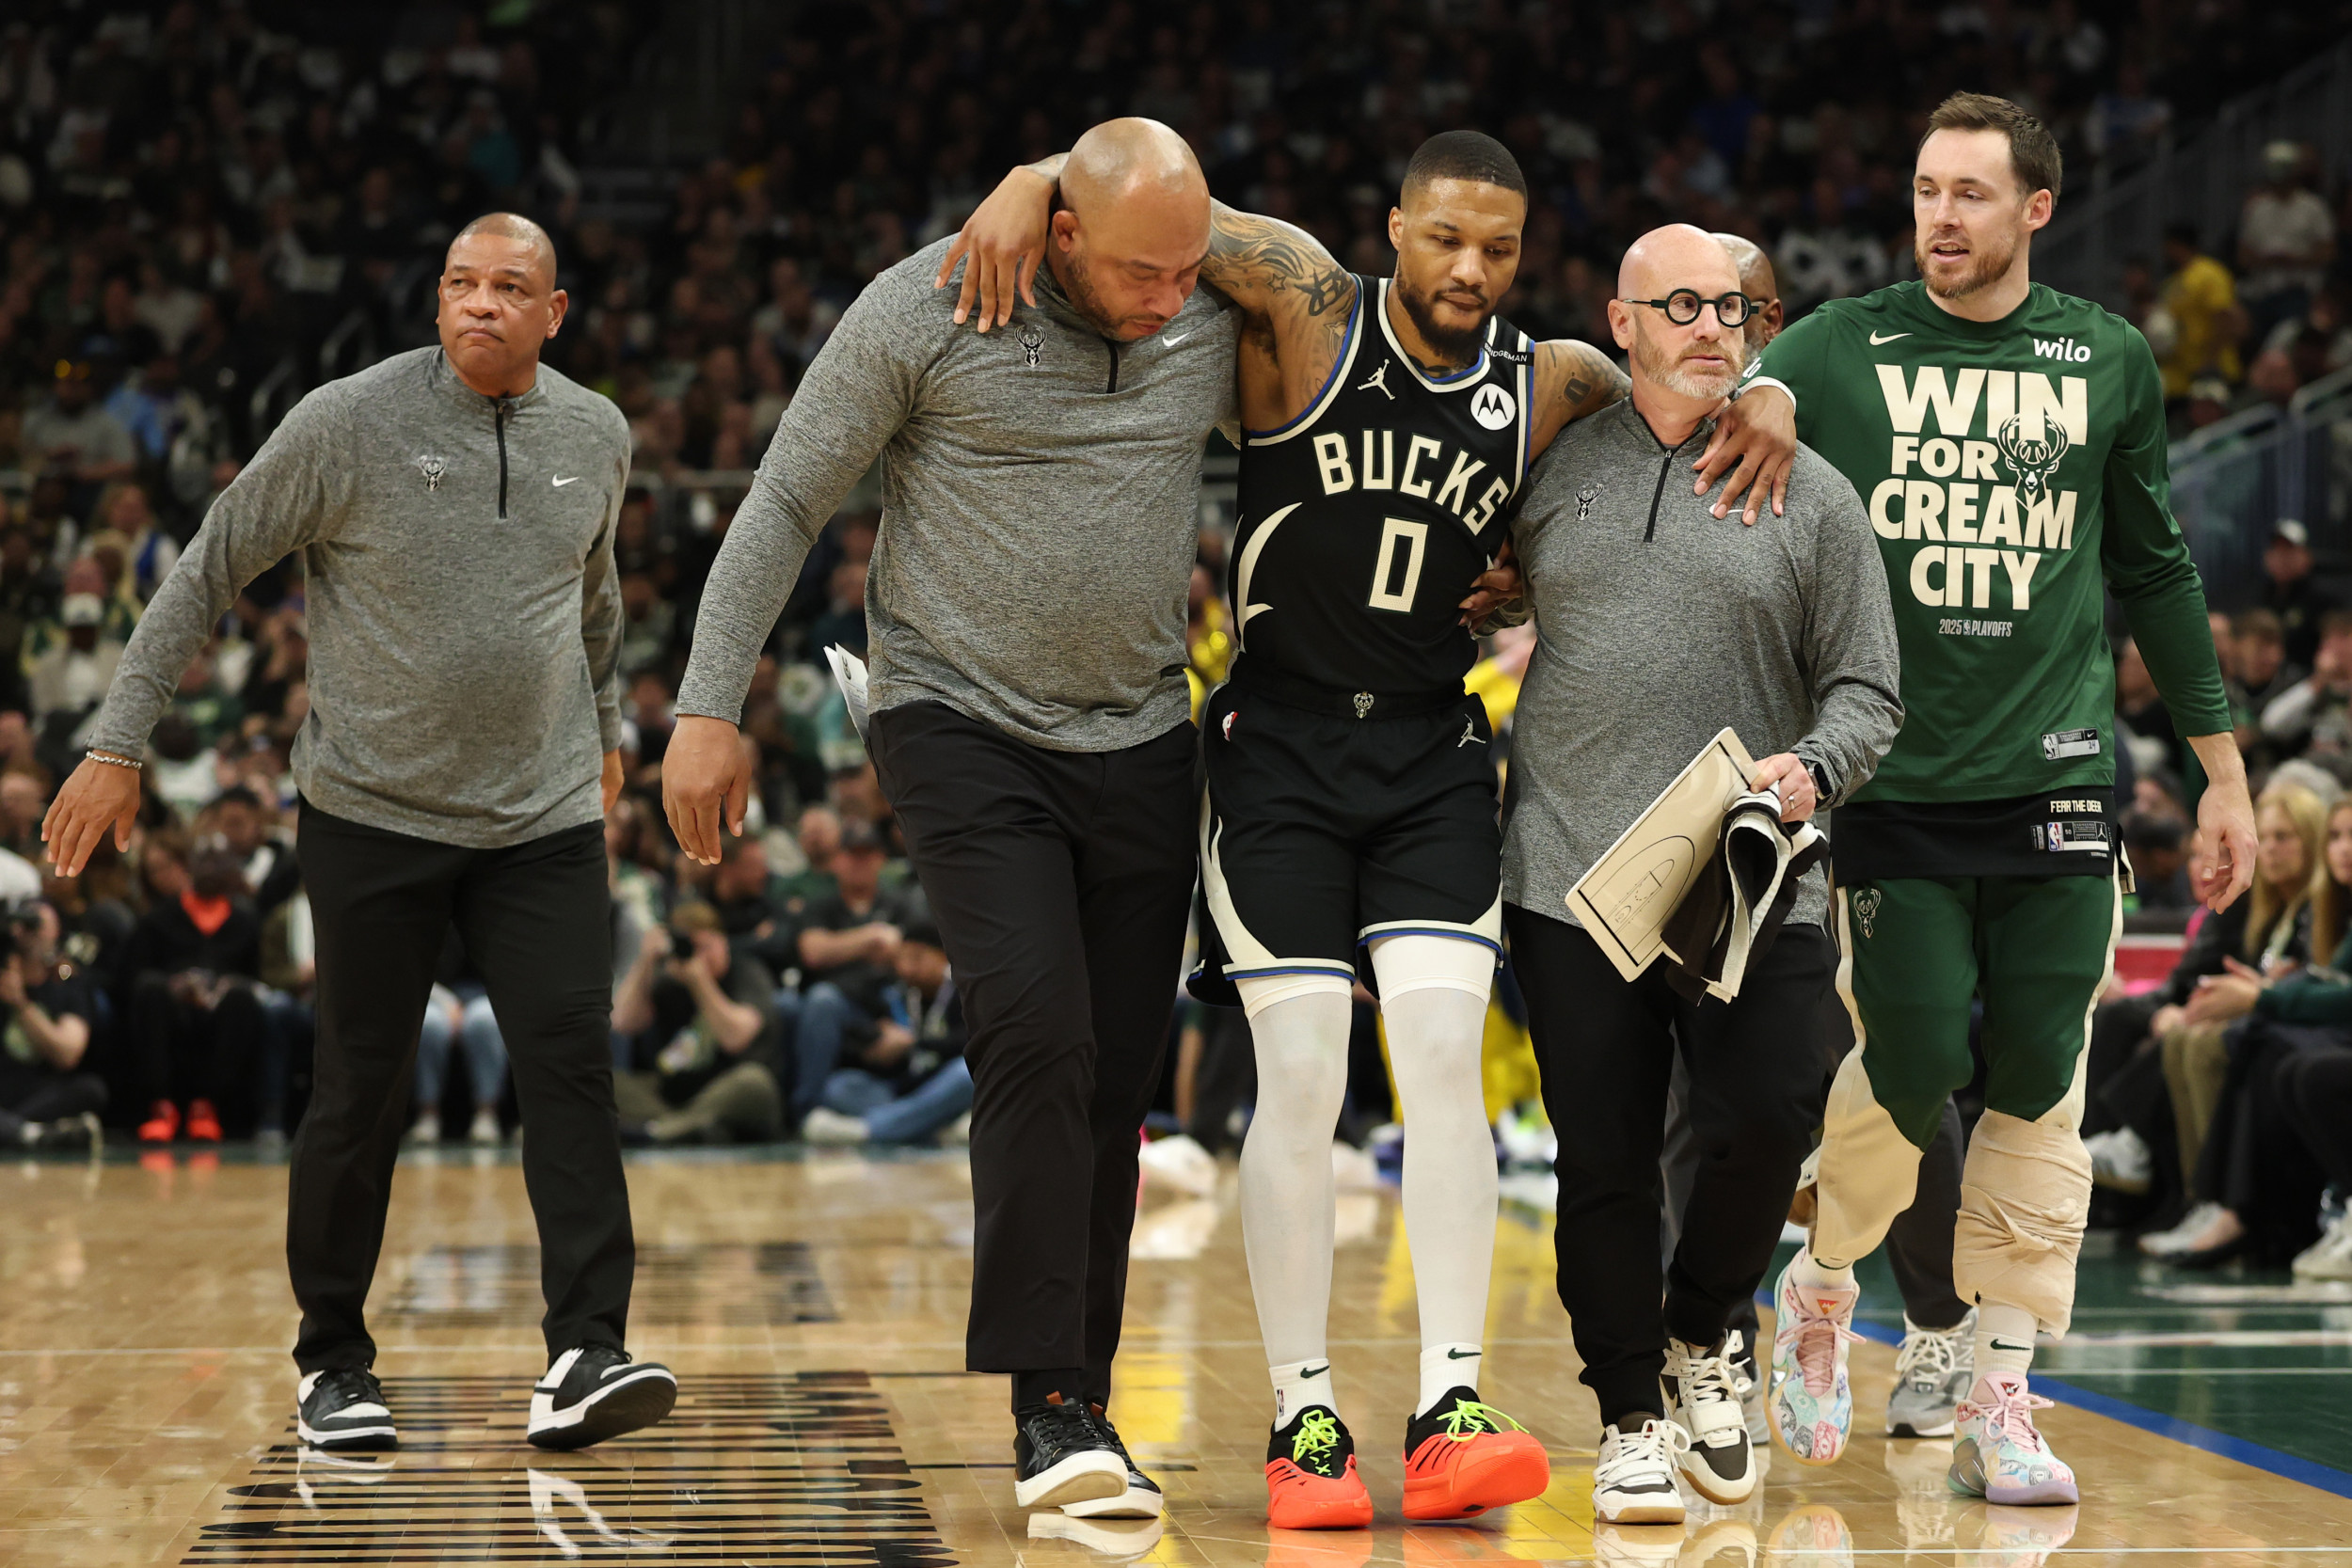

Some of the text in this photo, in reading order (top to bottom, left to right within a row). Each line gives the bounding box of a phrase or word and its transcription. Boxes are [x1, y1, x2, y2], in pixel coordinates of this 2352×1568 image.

[1485, 342, 1528, 362] BRIDGEMAN
[2033, 337, 2091, 362] wilo
[1875, 364, 2088, 446] WIN
[1312, 428, 1510, 536] BUCKS
[1891, 436, 1999, 481] FOR
[1869, 479, 2077, 549] CREAM
[1367, 516, 1429, 613] 0
[1910, 546, 2042, 610] CITY
[1939, 619, 2012, 637] 2025 PLAYOFFS
[2050, 800, 2103, 813] FEAR THE DEER
